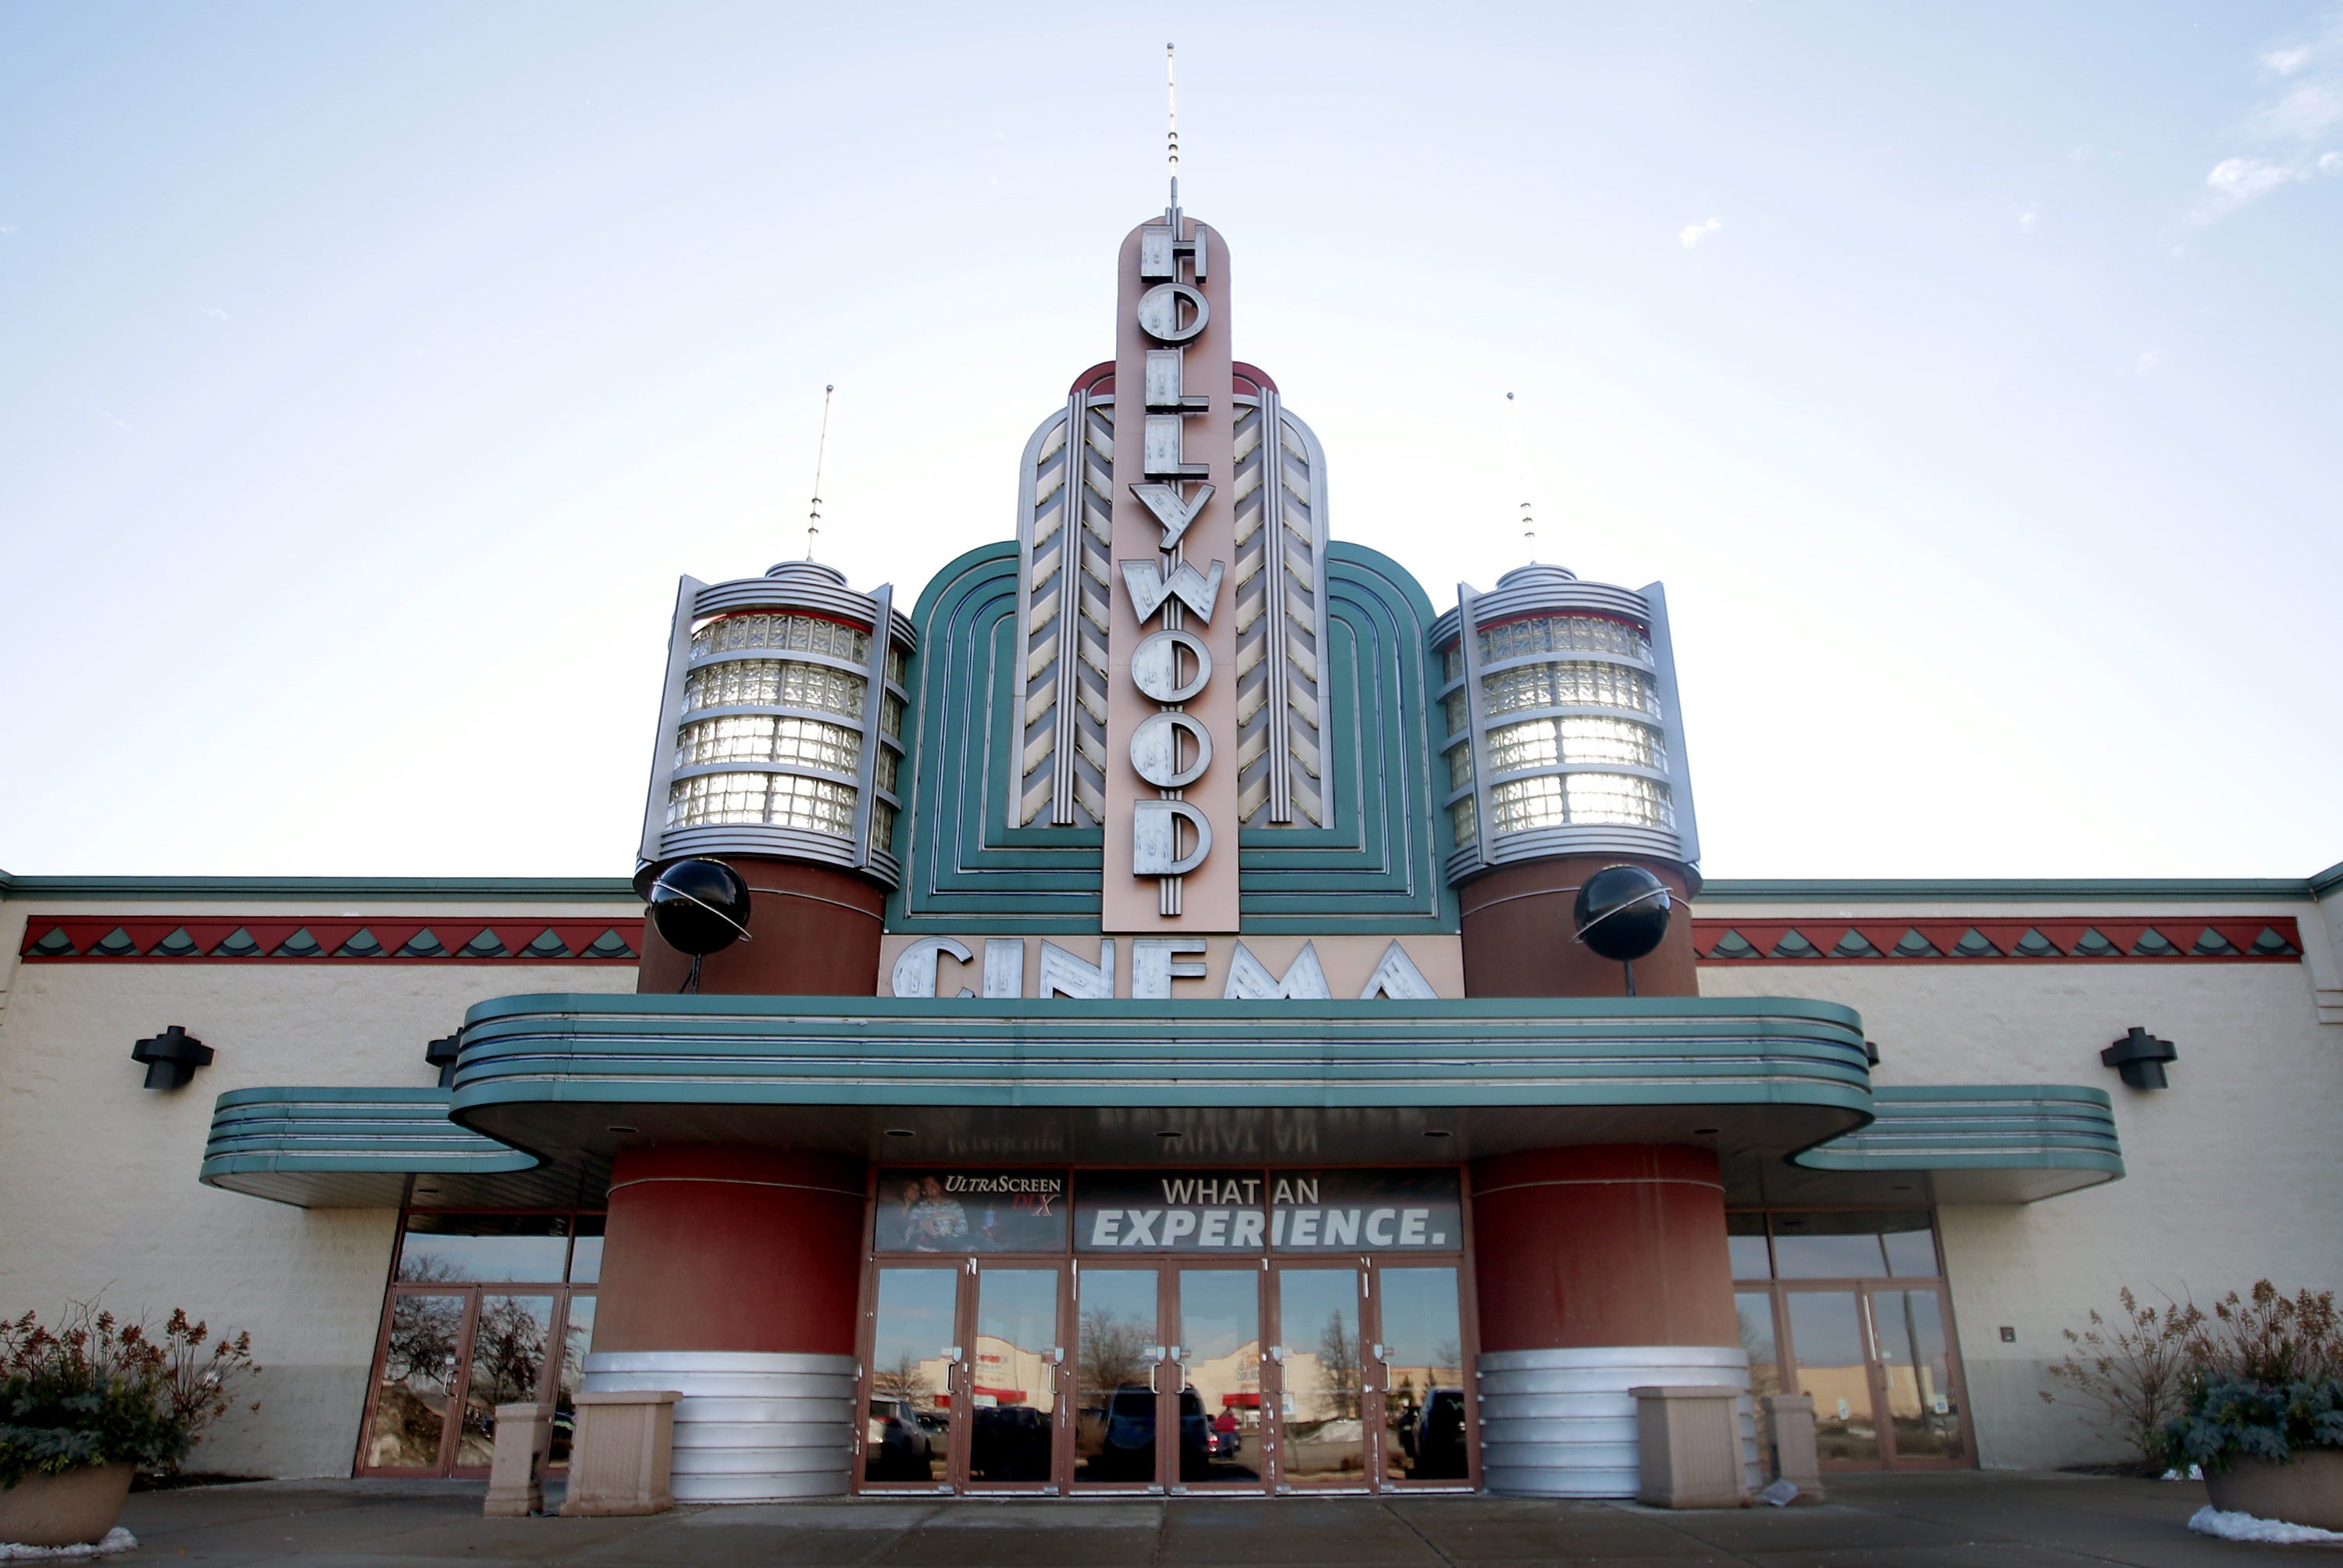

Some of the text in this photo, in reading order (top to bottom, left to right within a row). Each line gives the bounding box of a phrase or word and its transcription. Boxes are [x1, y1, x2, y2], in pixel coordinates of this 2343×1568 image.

[1118, 224, 1225, 878] HOLLYWOOD
[891, 935, 1440, 999] CINEMA
[1162, 1179, 1318, 1204] WHAT AN
[1092, 1209, 1445, 1246] EXPERIENCE.
